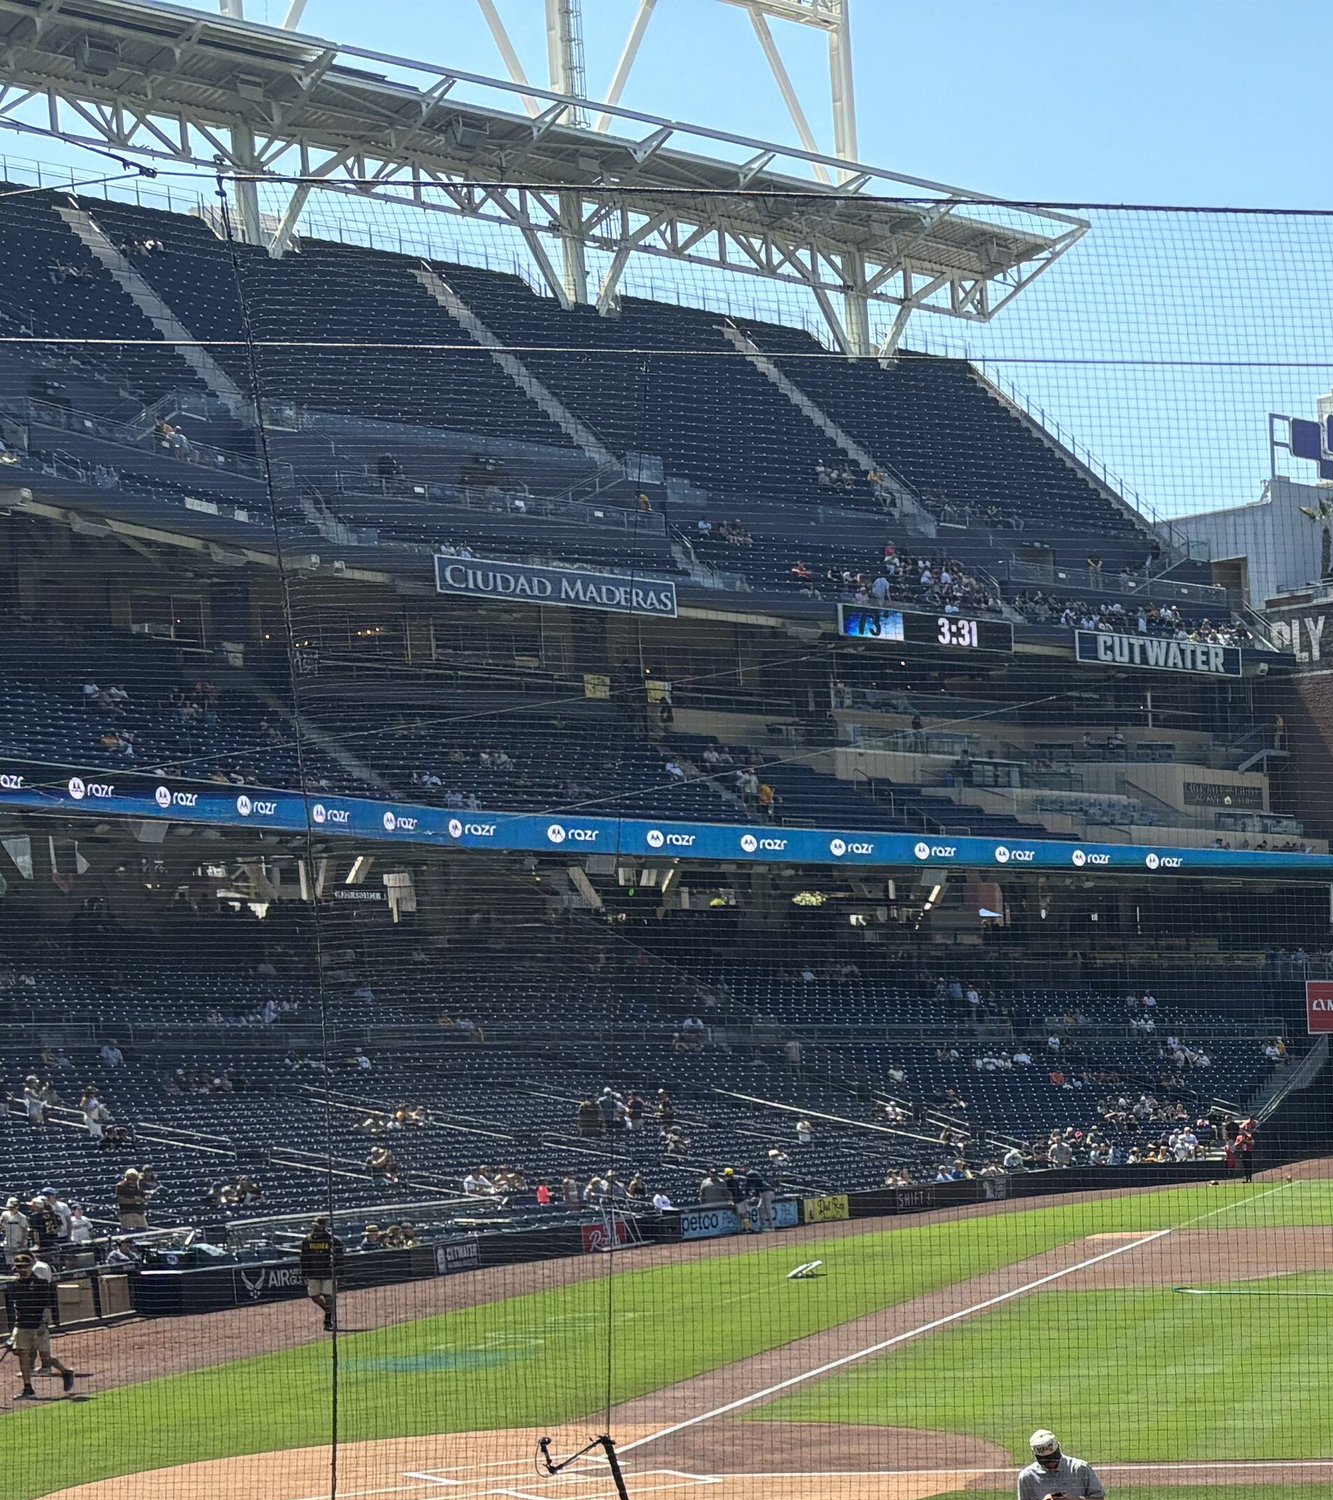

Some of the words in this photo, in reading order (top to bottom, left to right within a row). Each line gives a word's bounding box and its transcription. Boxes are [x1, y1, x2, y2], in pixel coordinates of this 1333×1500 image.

[444, 562, 553, 600] CIUDAD
[560, 575, 673, 612] MADERAS
[937, 617, 978, 648] 3:31
[1097, 634, 1225, 673] CUTWATER
[0, 774, 24, 790] azr
[87, 784, 115, 798] razr
[172, 792, 198, 807] razr
[253, 800, 277, 816] razr
[327, 809, 350, 823] razr
[397, 816, 418, 830] razr
[465, 823, 496, 837] razr
[568, 828, 599, 842] razr
[666, 833, 696, 847] razr
[759, 838, 788, 851] razr
[847, 841, 874, 854] razr
[931, 846, 956, 858] razr
[1010, 849, 1035, 862] razr
[1087, 853, 1111, 866] razr
[1160, 856, 1183, 868] razr
[268, 1270, 290, 1288] AIR
